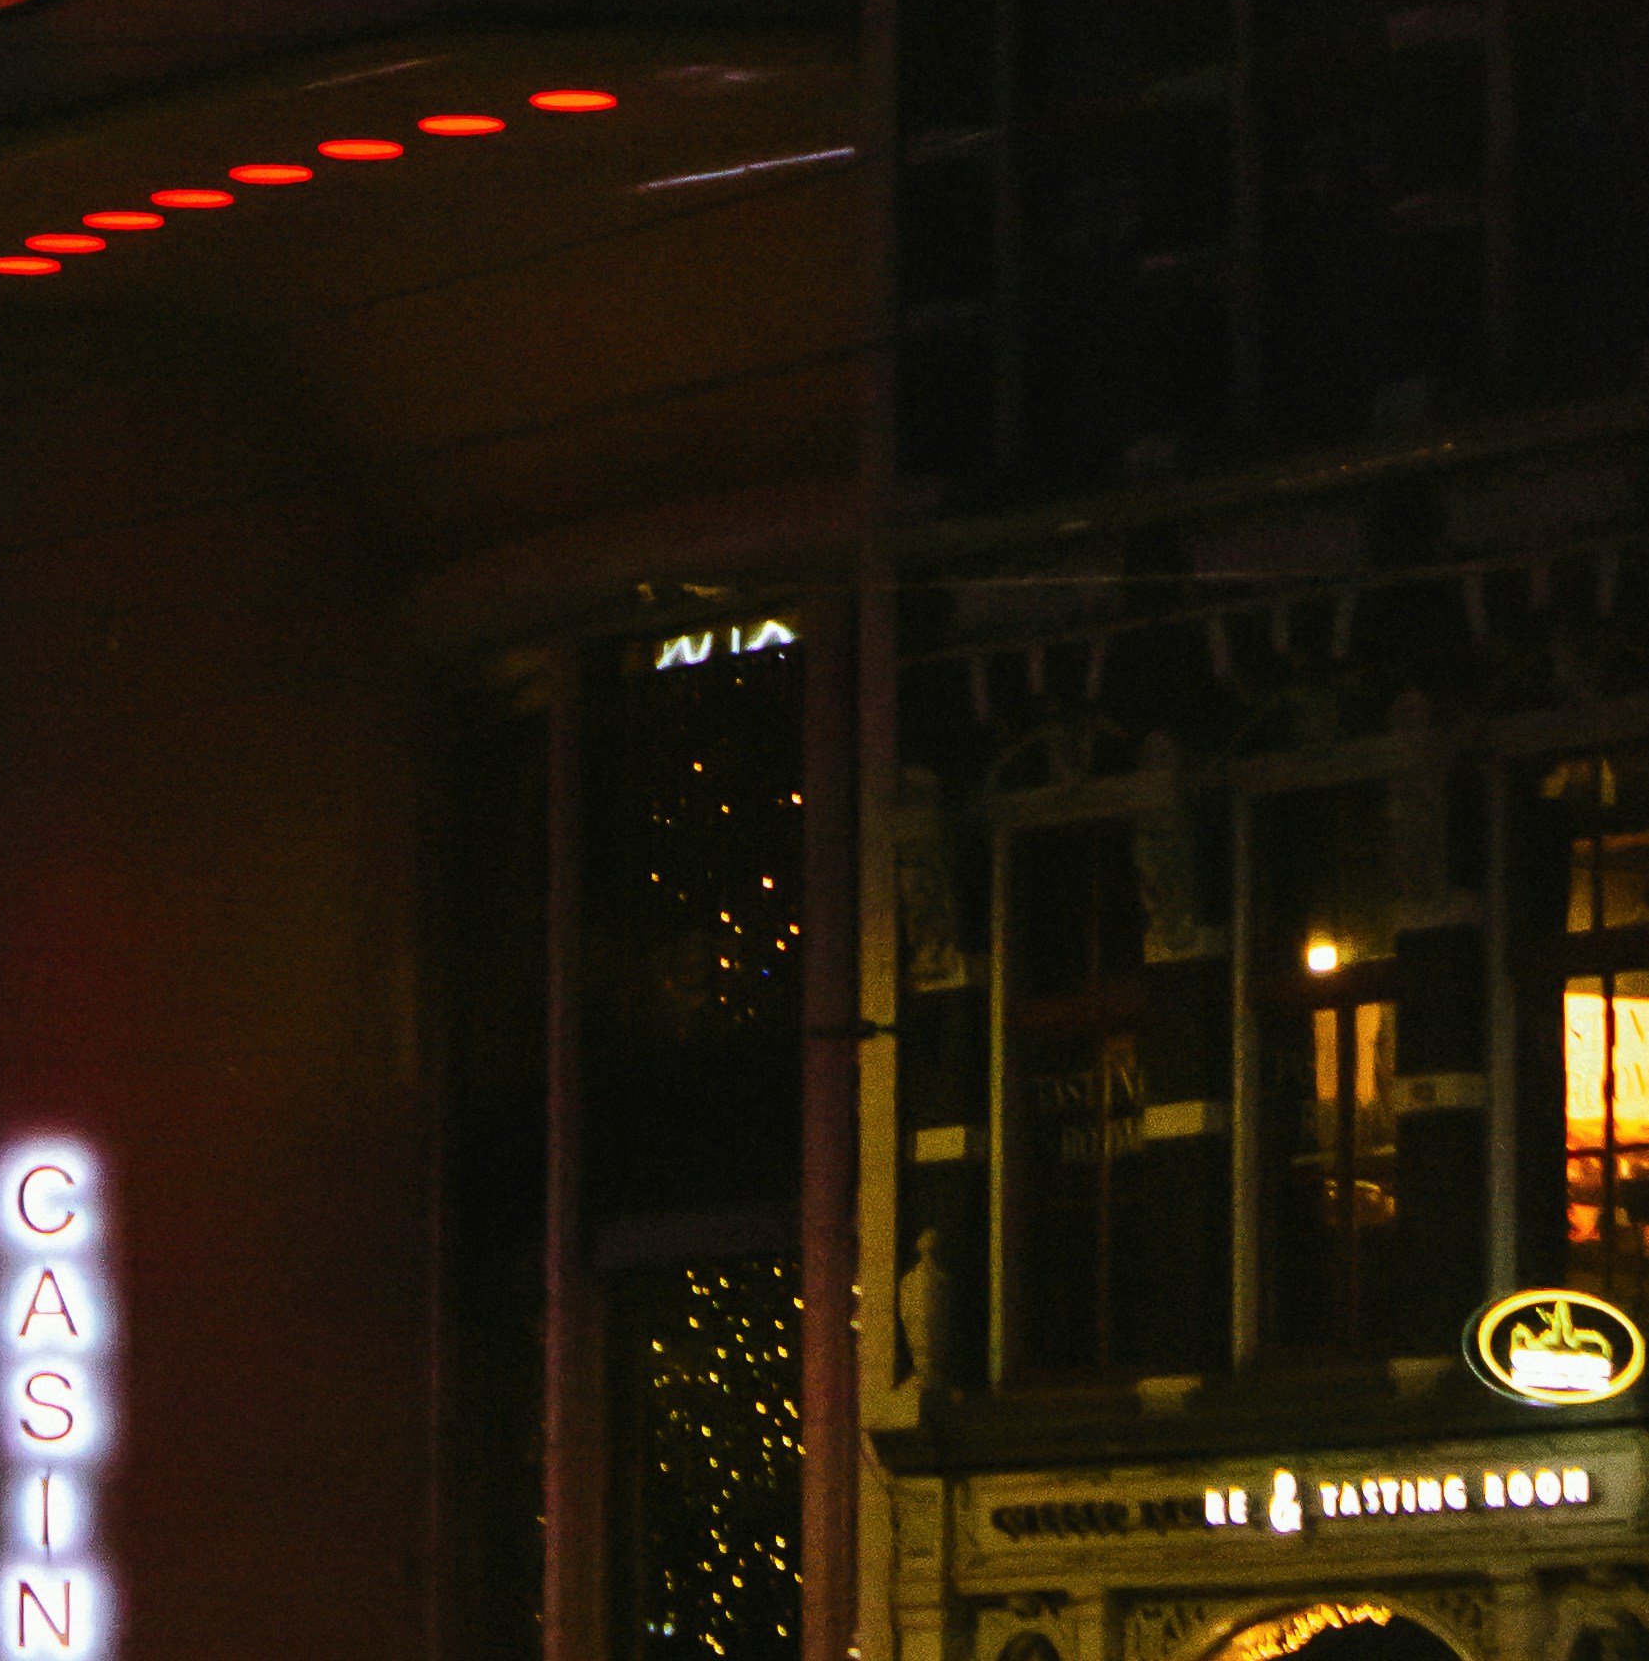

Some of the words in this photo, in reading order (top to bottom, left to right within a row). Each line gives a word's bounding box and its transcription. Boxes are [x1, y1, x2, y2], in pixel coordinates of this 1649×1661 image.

[17, 1164, 79, 1648] CASIN
[1269, 1468, 1302, 1534] &
[1319, 1473, 1469, 1519] TASTING
[1483, 1465, 1591, 1510] ROOM
